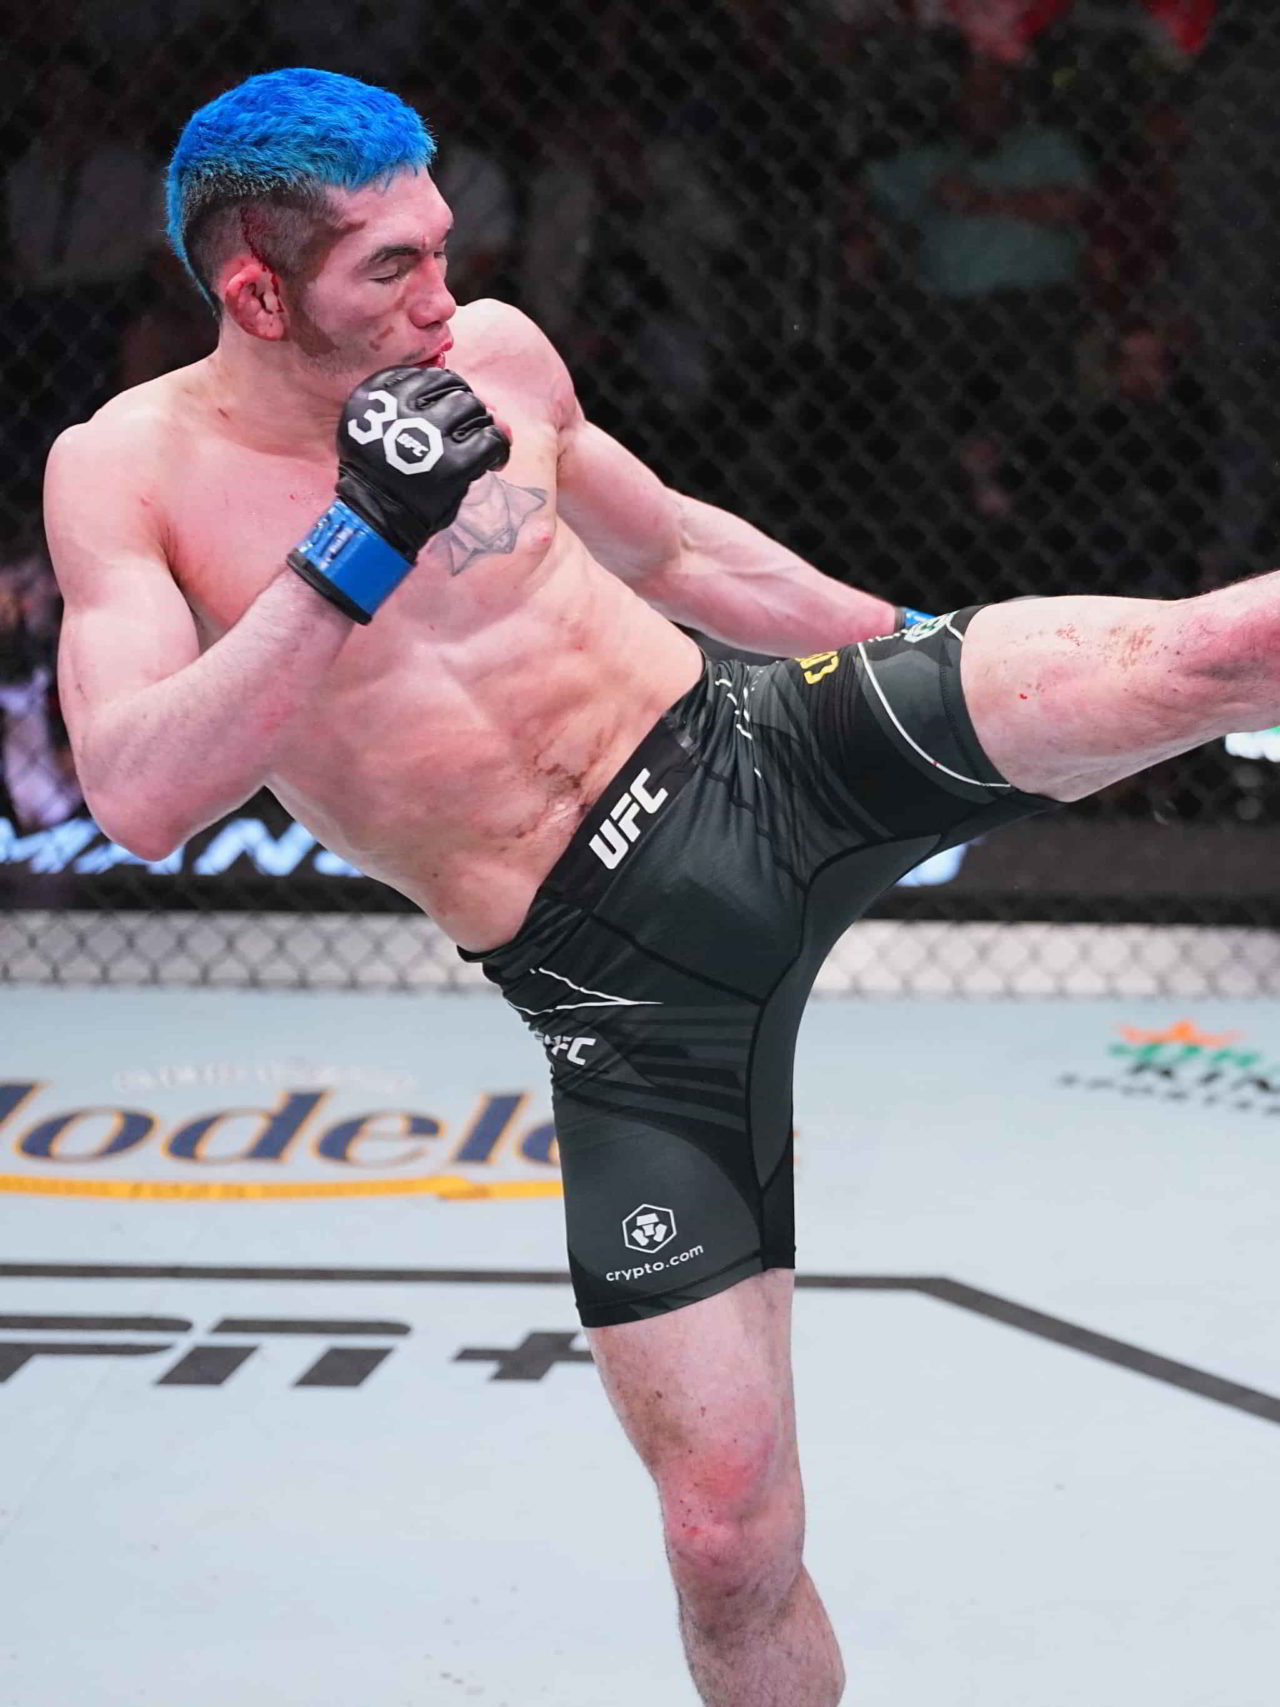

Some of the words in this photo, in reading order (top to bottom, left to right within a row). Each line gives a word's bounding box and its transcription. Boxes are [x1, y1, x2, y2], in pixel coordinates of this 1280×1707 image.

[348, 390, 444, 475] 30
[588, 767, 669, 870] UFC
[0, 1080, 563, 1166] odel
[606, 1244, 705, 1281] crypto.com
